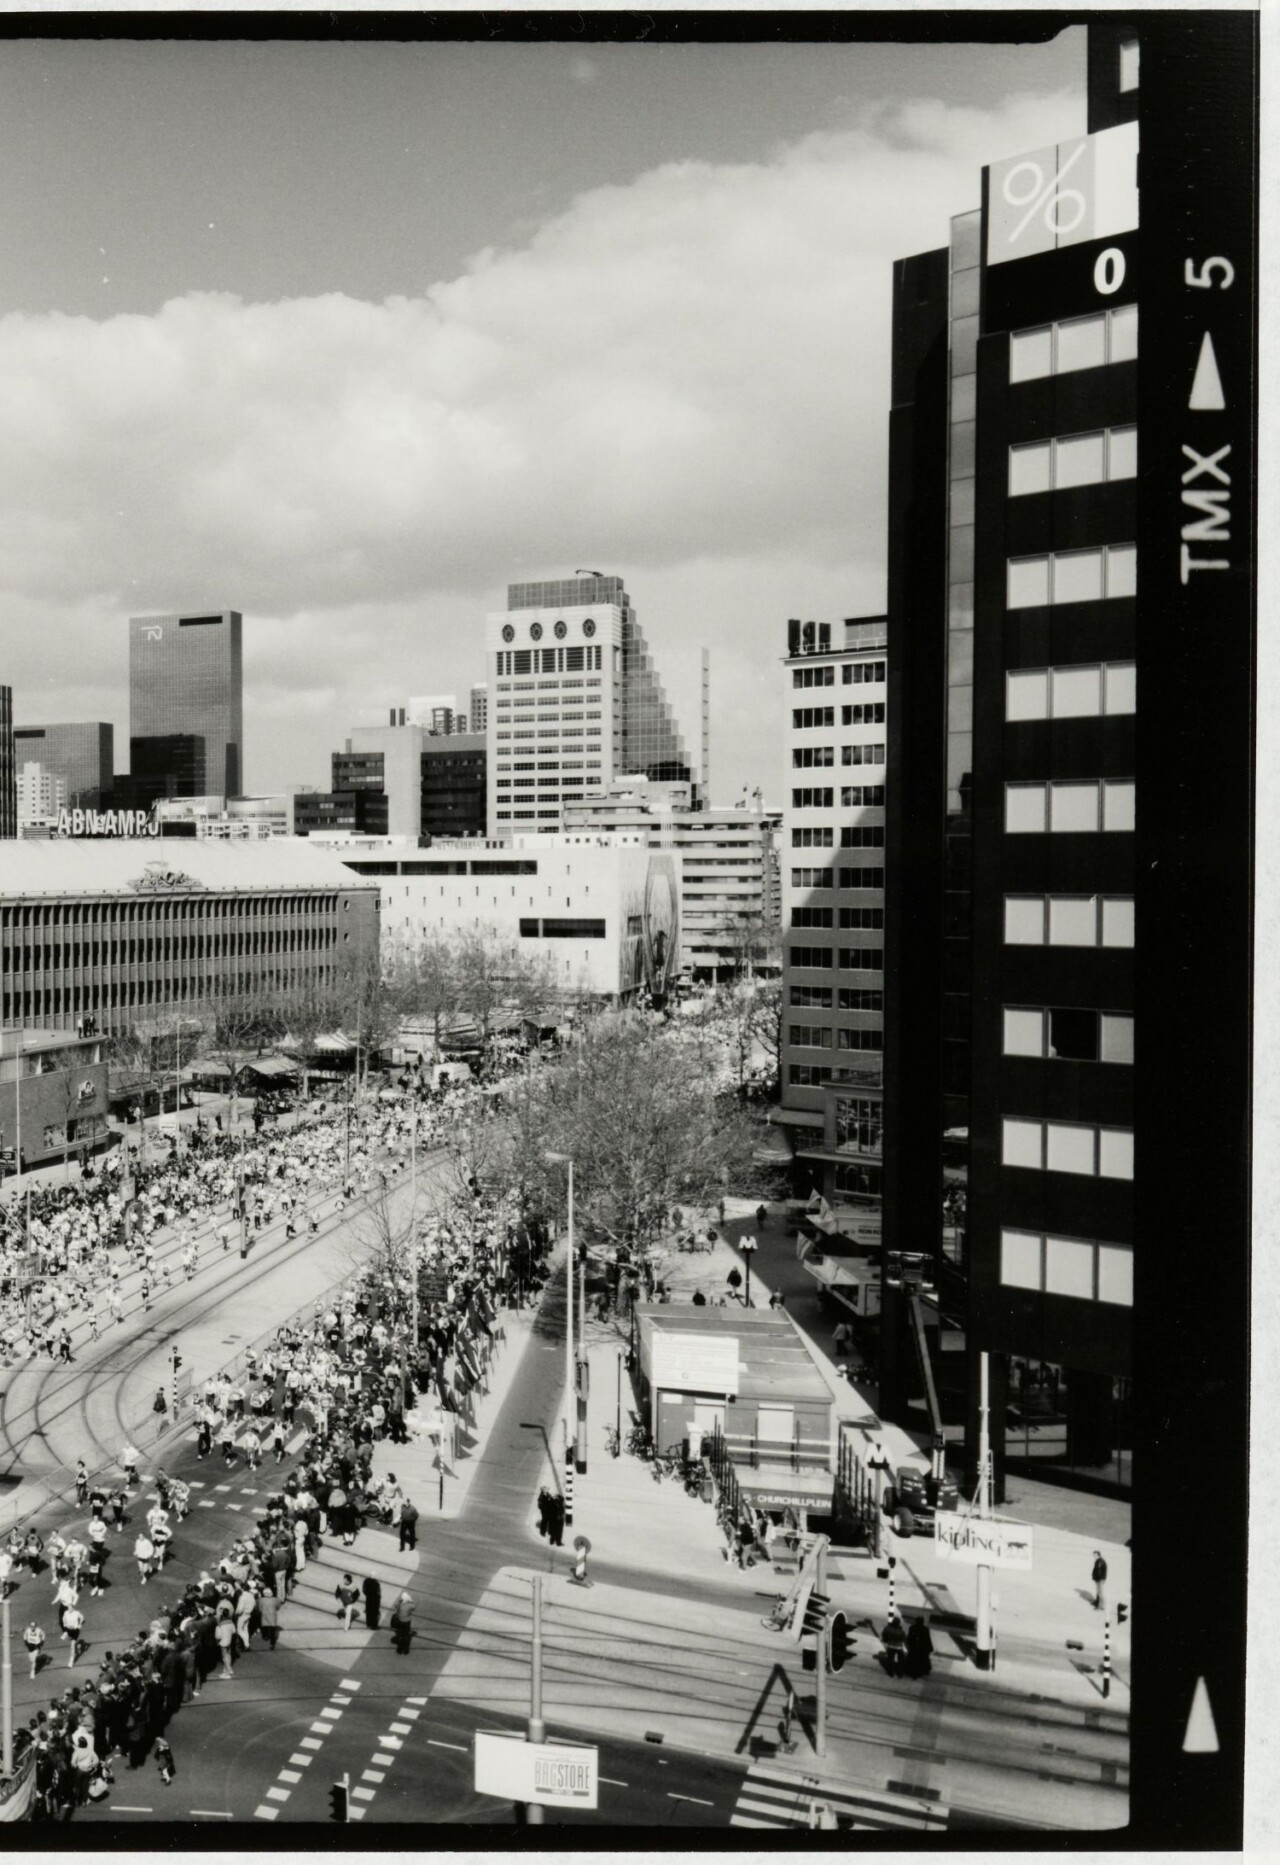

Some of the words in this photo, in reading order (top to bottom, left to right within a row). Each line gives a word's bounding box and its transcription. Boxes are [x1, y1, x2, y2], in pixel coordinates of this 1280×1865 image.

[1184, 256, 1235, 290] 5
[1180, 443, 1231, 585] TMX
[58, 808, 97, 835] ABN
[757, 1495, 832, 1508] CHURCHILLPLEIN
[938, 1522, 1001, 1557] kipling
